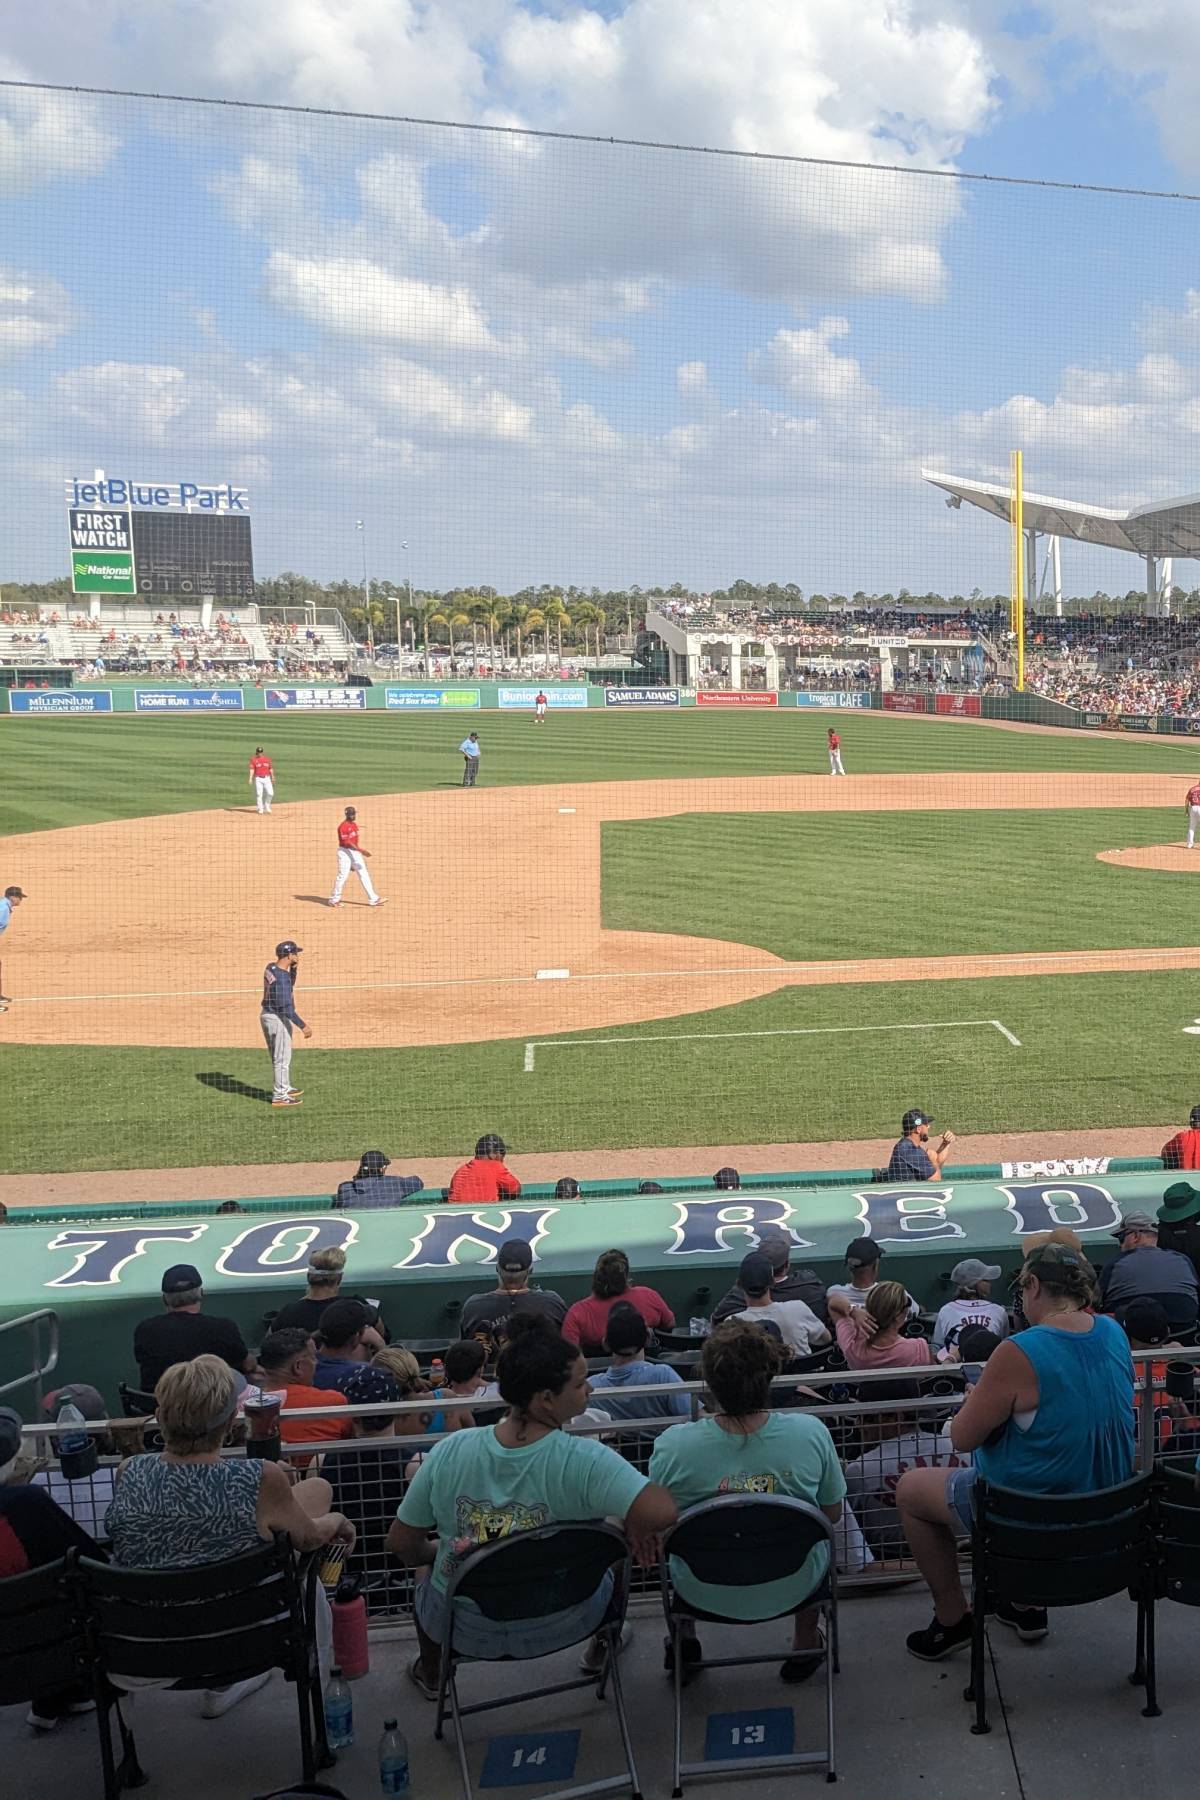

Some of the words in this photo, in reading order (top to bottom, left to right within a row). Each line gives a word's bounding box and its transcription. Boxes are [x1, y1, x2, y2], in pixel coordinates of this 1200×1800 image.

[72, 477, 170, 508] jetBlue
[180, 482, 244, 510] Park
[77, 513, 122, 530] FIRST
[73, 530, 127, 548] WATCH
[88, 565, 131, 575] National
[141, 579, 152, 591] 0
[296, 690, 360, 700] BEST
[608, 691, 644, 702] SAMUEL
[645, 691, 677, 702] ADAMS
[680, 689, 696, 697] 380
[741, 695, 772, 703] University
[29, 697, 94, 706] MILLENNIUM
[140, 698, 167, 706] HOME
[168, 698, 189, 706] RUN!
[839, 694, 863, 707] CAFE
[663, 1181, 1125, 1256] RED
[960, 1315, 992, 1328] BETTS
[730, 1724, 765, 1745] 13
[511, 1745, 547, 1767] 14
